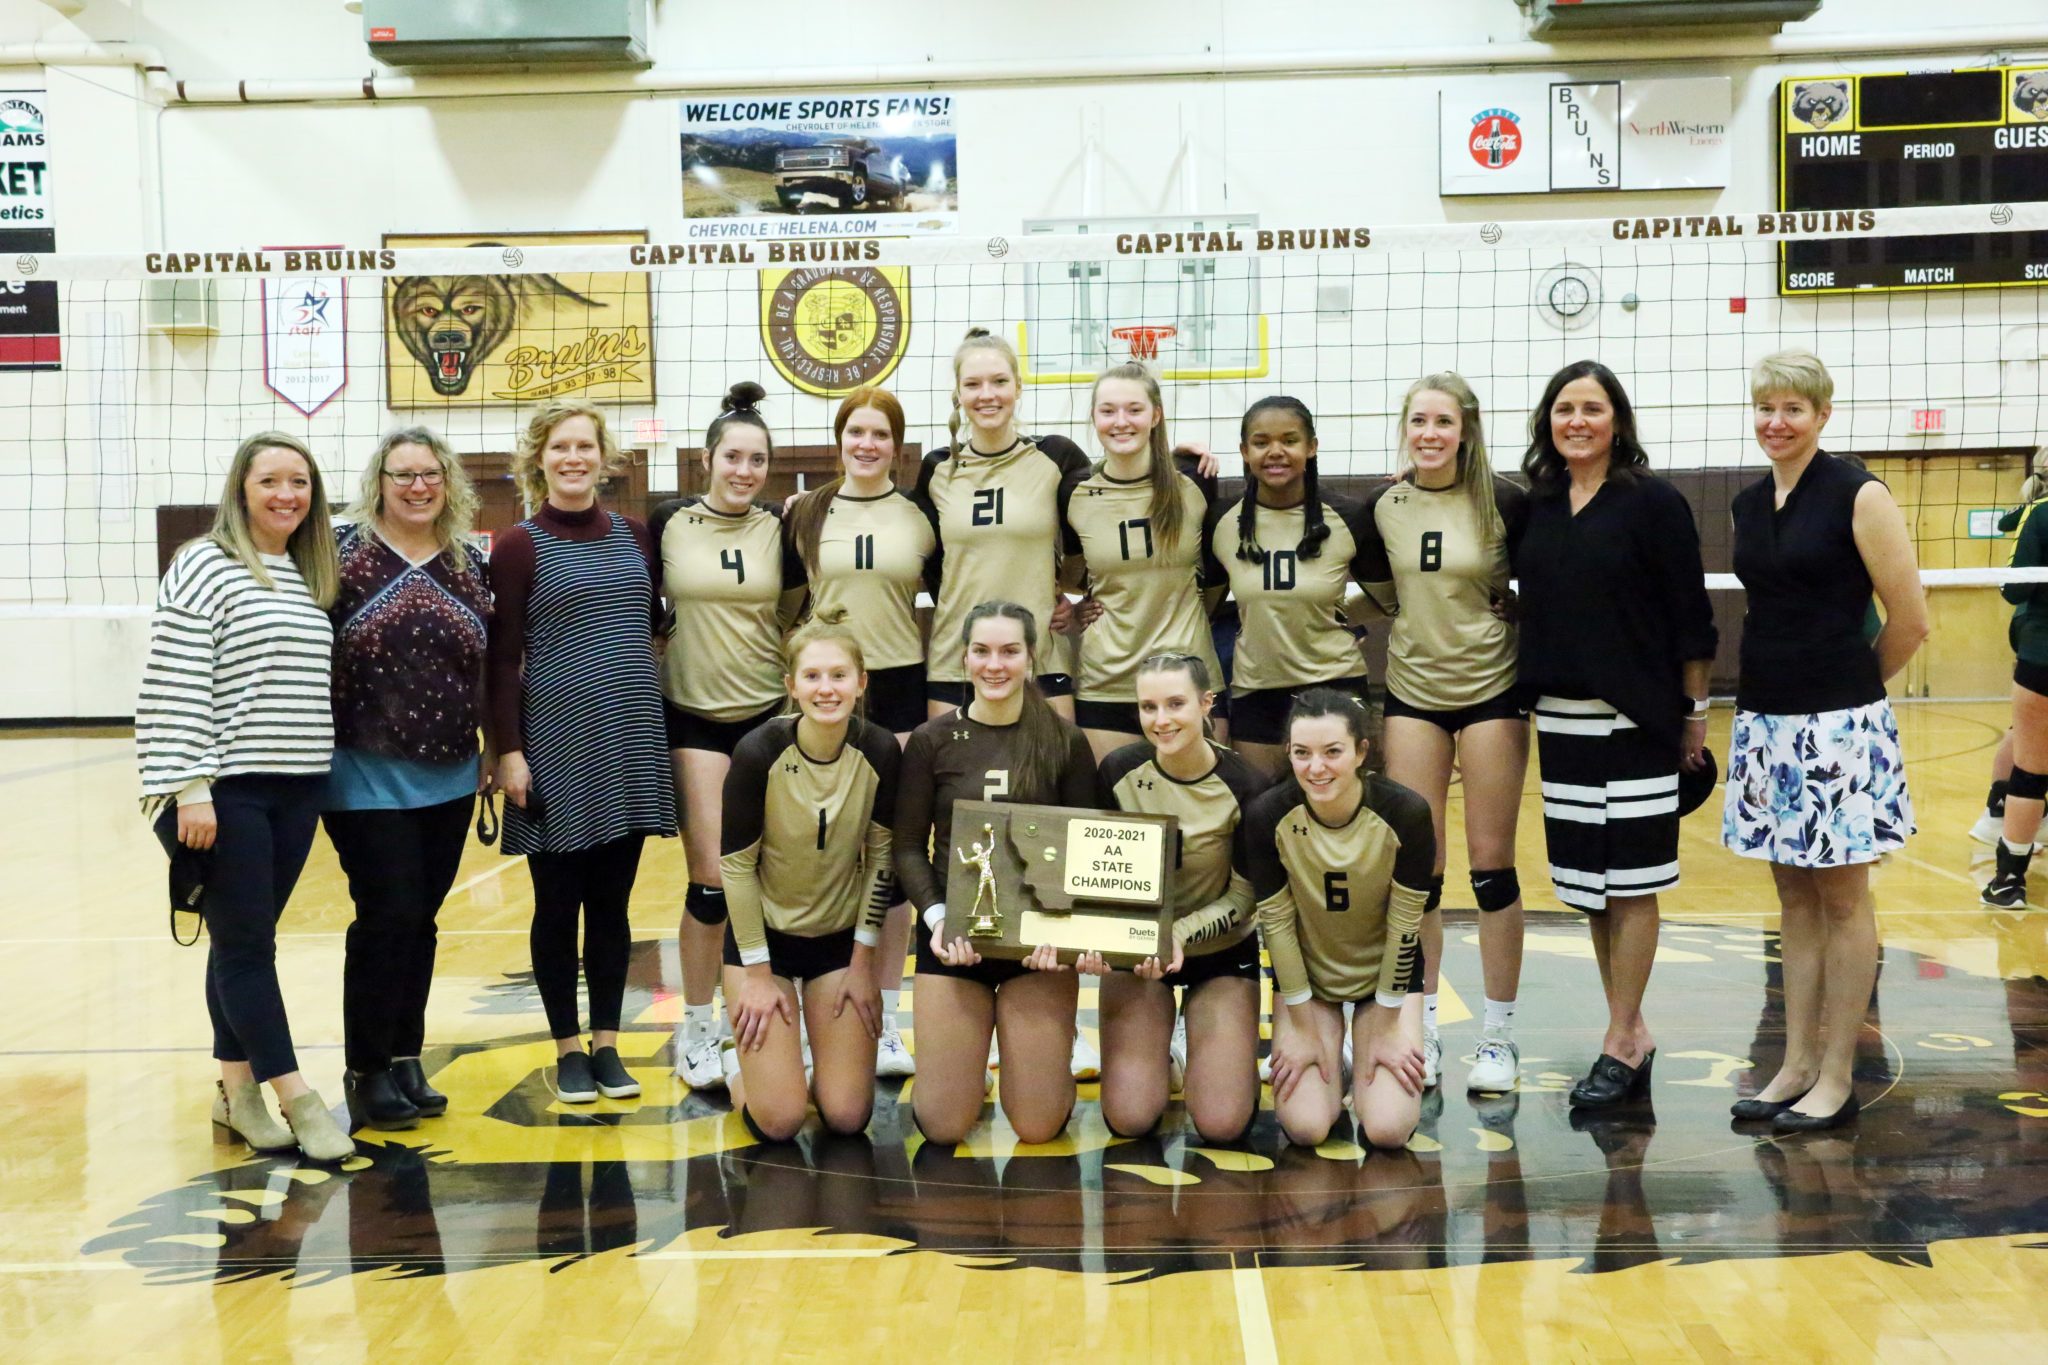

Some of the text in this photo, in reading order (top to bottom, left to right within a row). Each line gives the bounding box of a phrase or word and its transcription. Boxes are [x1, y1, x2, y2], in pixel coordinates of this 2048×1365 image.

[686, 97, 950, 122] WELCOME SPORTS FANS!
[786, 122, 834, 131] CHEVROLET
[1629, 120, 1724, 136] NrthWestern
[1801, 135, 1861, 157] HOME
[1904, 143, 1955, 159] PERIOD
[1613, 210, 1876, 240] CAPITAL BRUINS
[630, 240, 880, 265] CAPITAL BRUINS
[1116, 227, 1371, 254] CAPITAL BRUINS
[146, 250, 396, 273] CAPITAL BRUINS
[1789, 272, 1835, 288] SCORE
[1904, 268, 1954, 284] MATCH
[504, 325, 646, 390] Bruins
[1915, 410, 1943, 430] EXIT
[972, 487, 1004, 526] 21
[855, 534, 874, 569] 11
[1118, 517, 1153, 561] 17
[1420, 531, 1443, 572] 8
[720, 549, 745, 585] 4
[1263, 550, 1296, 590] 10
[984, 769, 1008, 802] 2
[816, 808, 826, 850] 1
[1084, 827, 1146, 842] 2020-2021
[1104, 845, 1122, 856] AA
[1092, 860, 1133, 874] STATE
[1071, 876, 1152, 892] CHAMPIONS
[1323, 871, 1350, 912] 6
[1129, 927, 1156, 936] Duets
